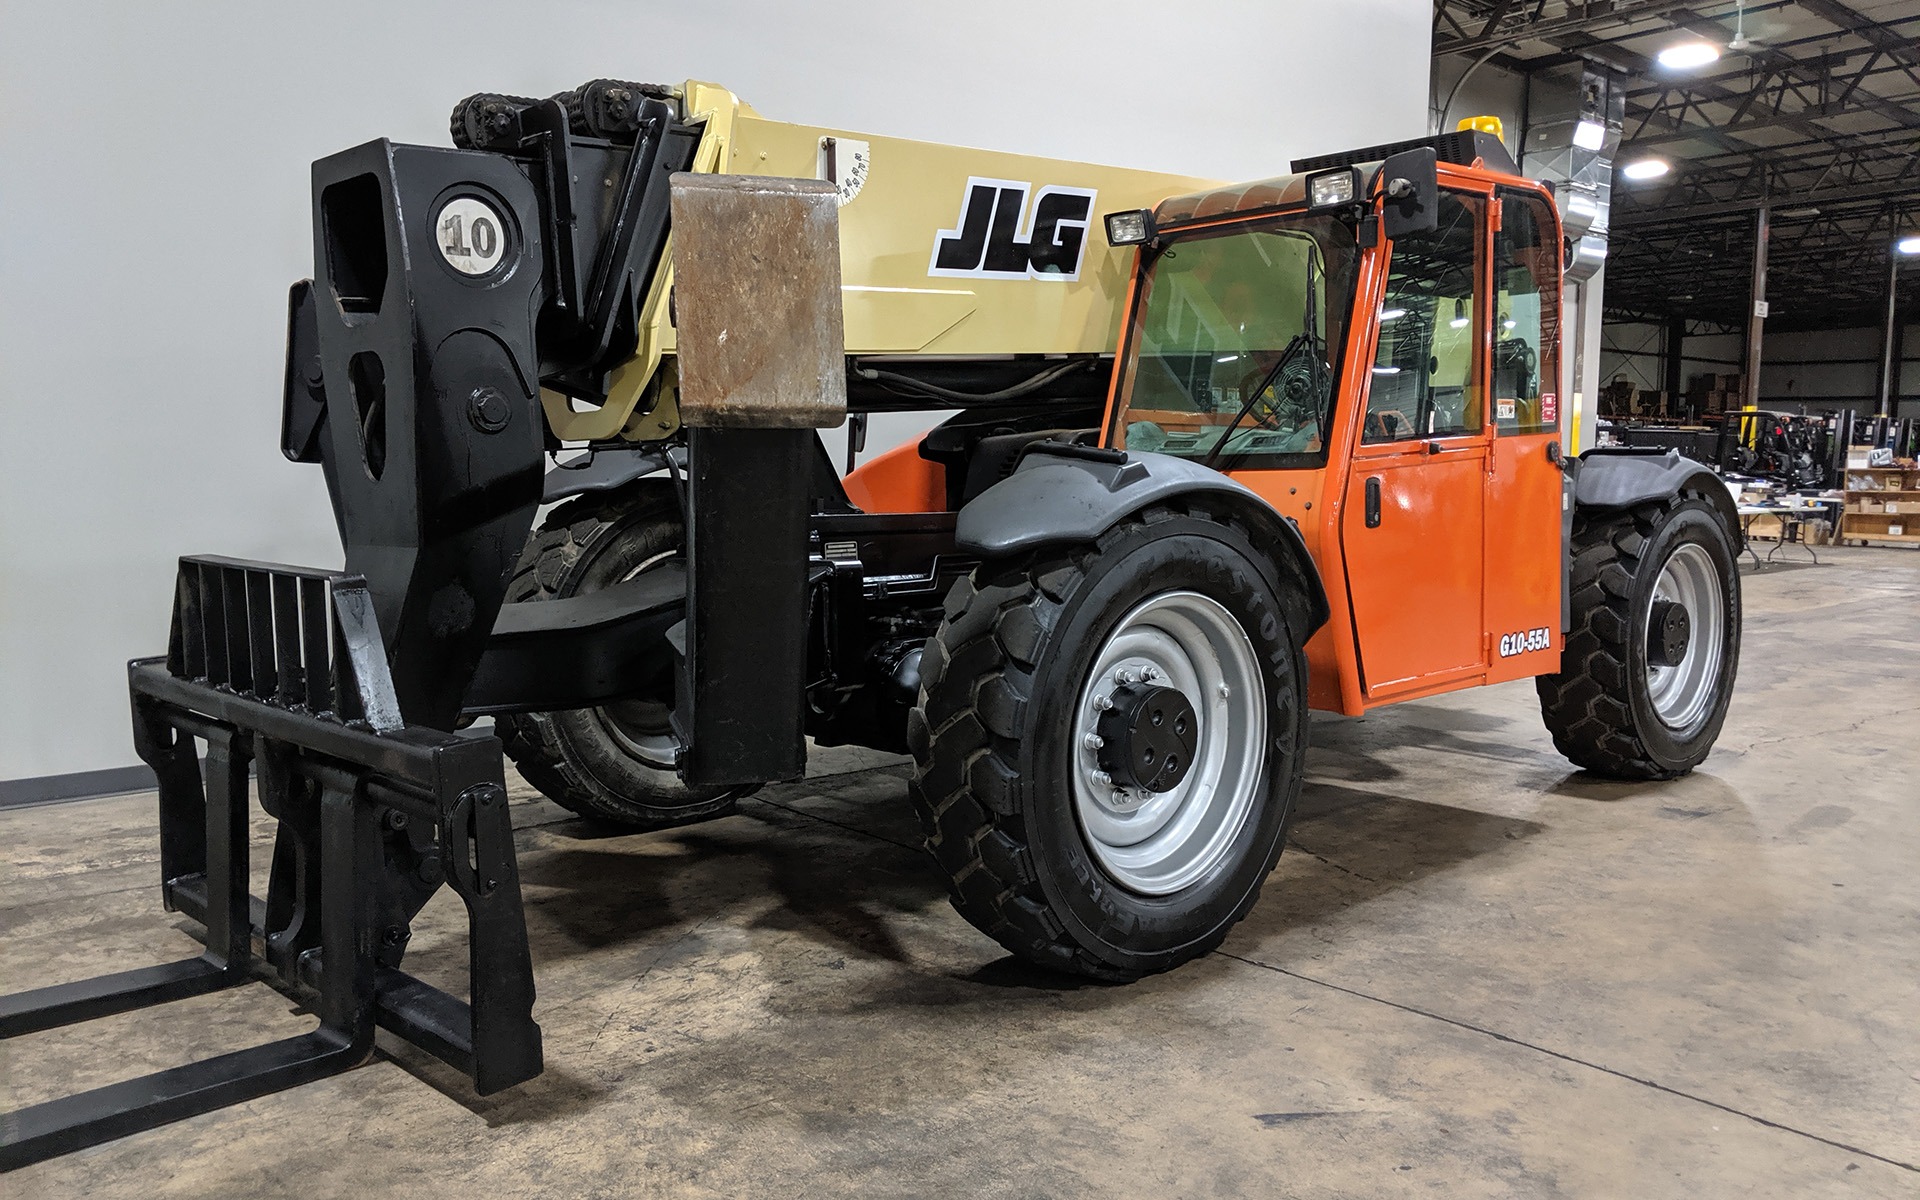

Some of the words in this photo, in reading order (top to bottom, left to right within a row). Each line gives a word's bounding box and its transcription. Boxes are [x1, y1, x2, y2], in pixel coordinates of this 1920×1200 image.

[445, 214, 497, 259] 10
[931, 181, 1094, 277] JLG
[1500, 627, 1550, 658] G10-55A
